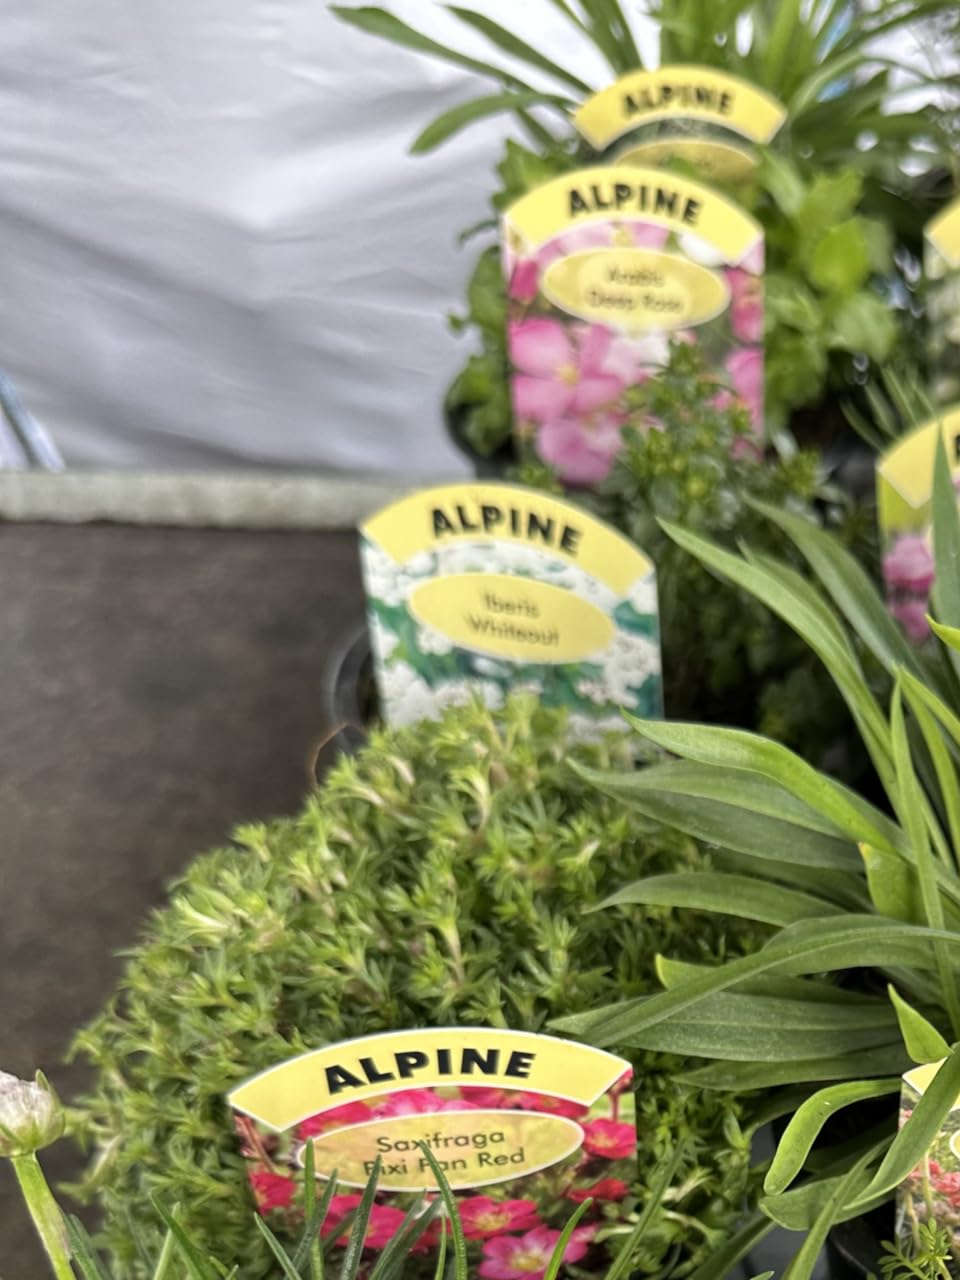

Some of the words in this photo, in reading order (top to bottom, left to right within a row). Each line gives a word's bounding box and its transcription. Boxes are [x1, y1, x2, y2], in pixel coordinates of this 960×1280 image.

[622, 83, 734, 115] ALPINE
[567, 182, 704, 224] ALPINE
[431, 504, 584, 556] ALPINE
[482, 590, 540, 618] Iberis
[467, 613, 560, 646] Whiteout
[324, 1046, 536, 1095] ALPINE
[376, 1130, 505, 1153] Saxifraga
[478, 1147, 526, 1168] Red
